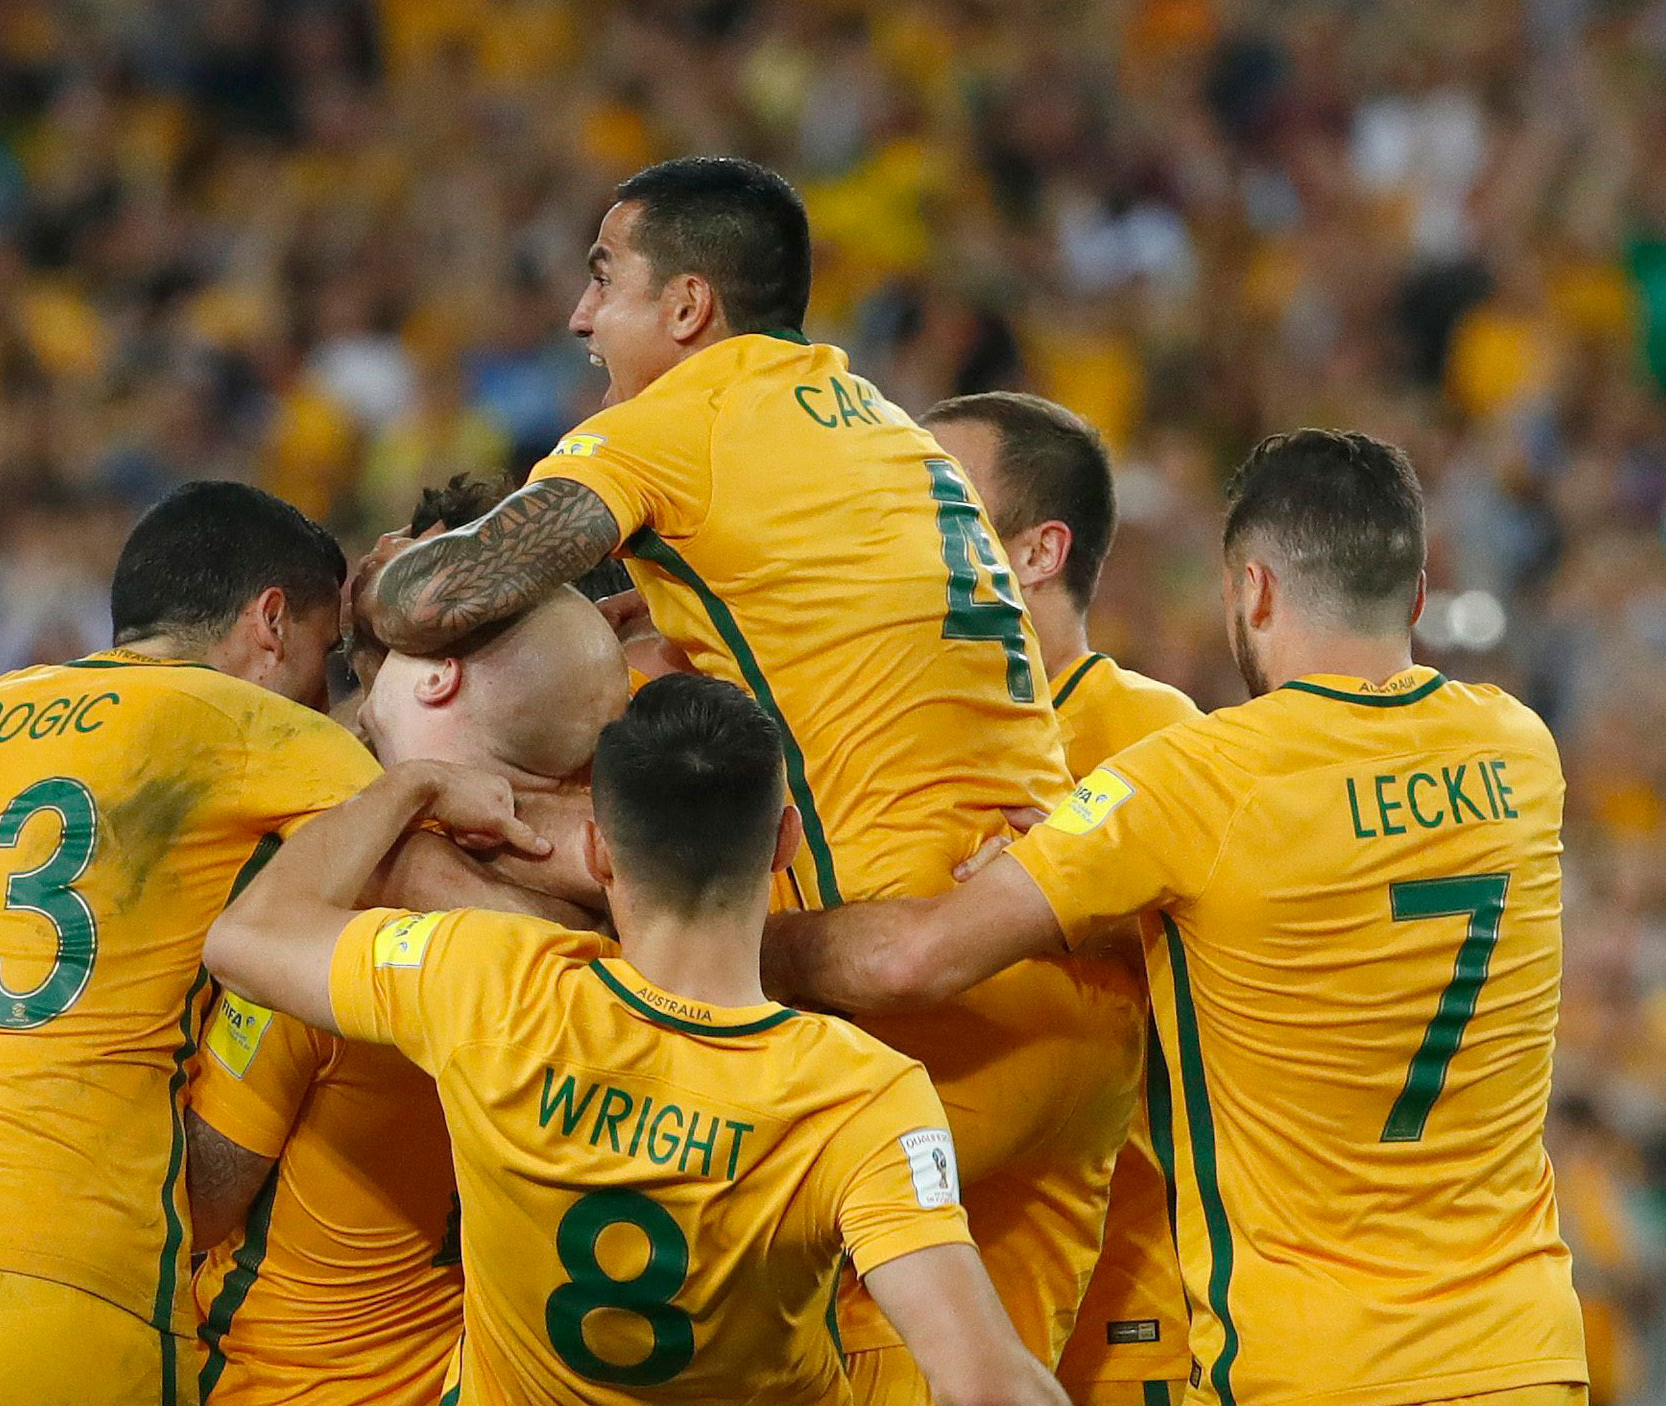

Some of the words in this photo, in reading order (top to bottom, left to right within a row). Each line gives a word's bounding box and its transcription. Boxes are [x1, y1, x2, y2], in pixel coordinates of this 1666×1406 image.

[794, 376, 883, 428] CAH
[924, 459, 1035, 704] 4
[1346, 761, 1519, 839] LECKIE
[637, 987, 712, 1023] AUSTRALIA
[1379, 872, 1510, 1143] 7
[537, 1067, 755, 1181] WRIGHT
[544, 1188, 695, 1387] 8
